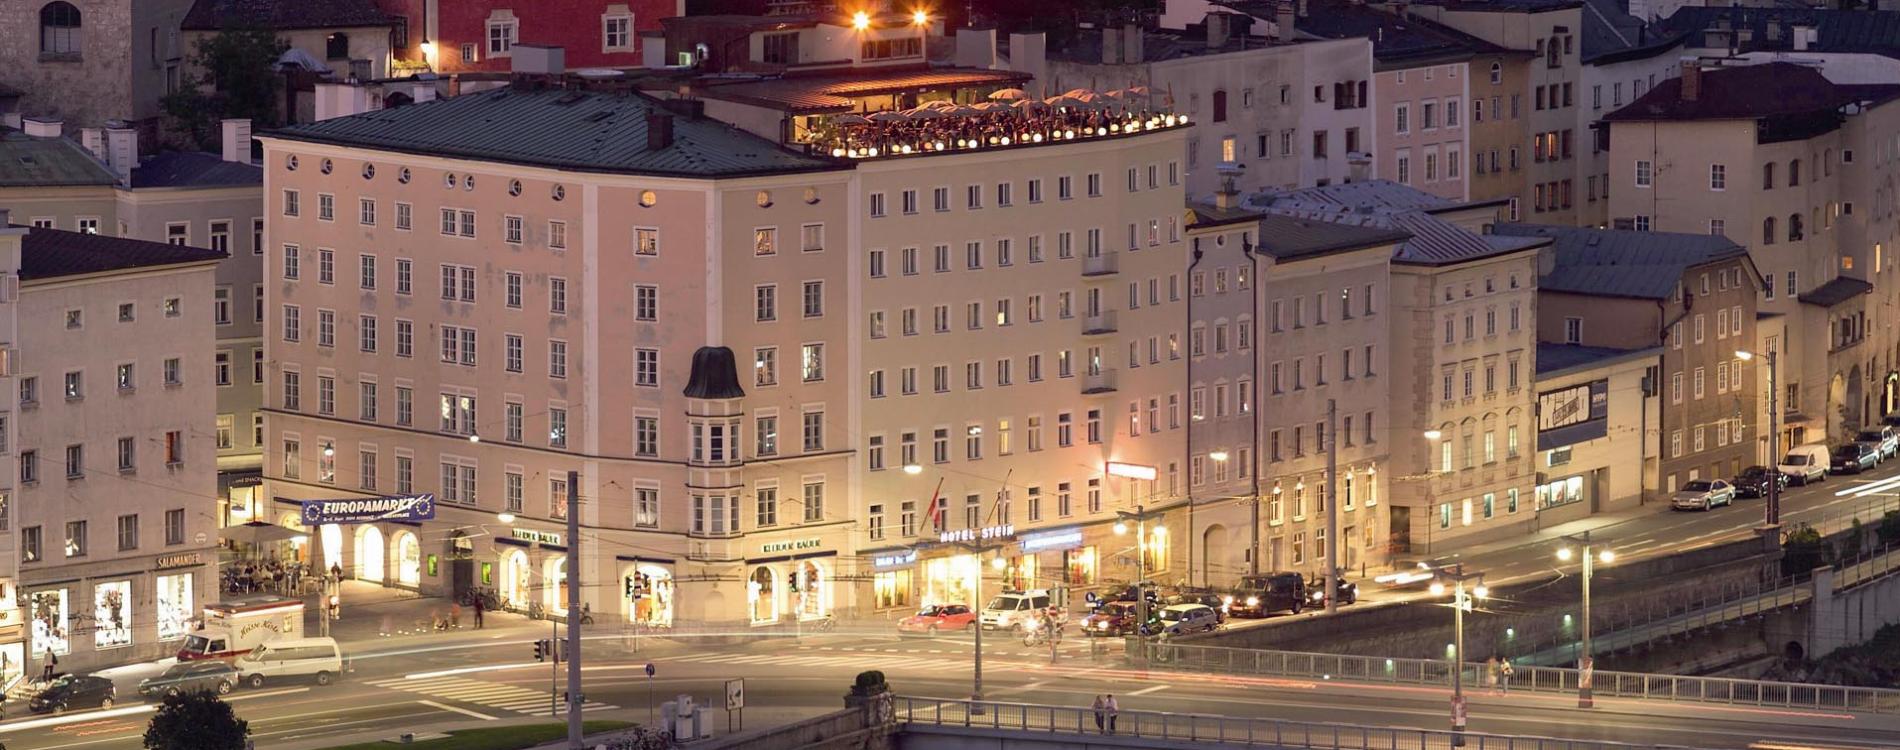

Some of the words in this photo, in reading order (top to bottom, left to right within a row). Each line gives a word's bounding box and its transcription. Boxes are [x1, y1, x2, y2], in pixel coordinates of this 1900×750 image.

[322, 497, 416, 514] EUROPAMARKT
[940, 529, 975, 543] HOTEL
[982, 525, 1014, 538] STEIN
[158, 552, 201, 569] SALAMANDER
